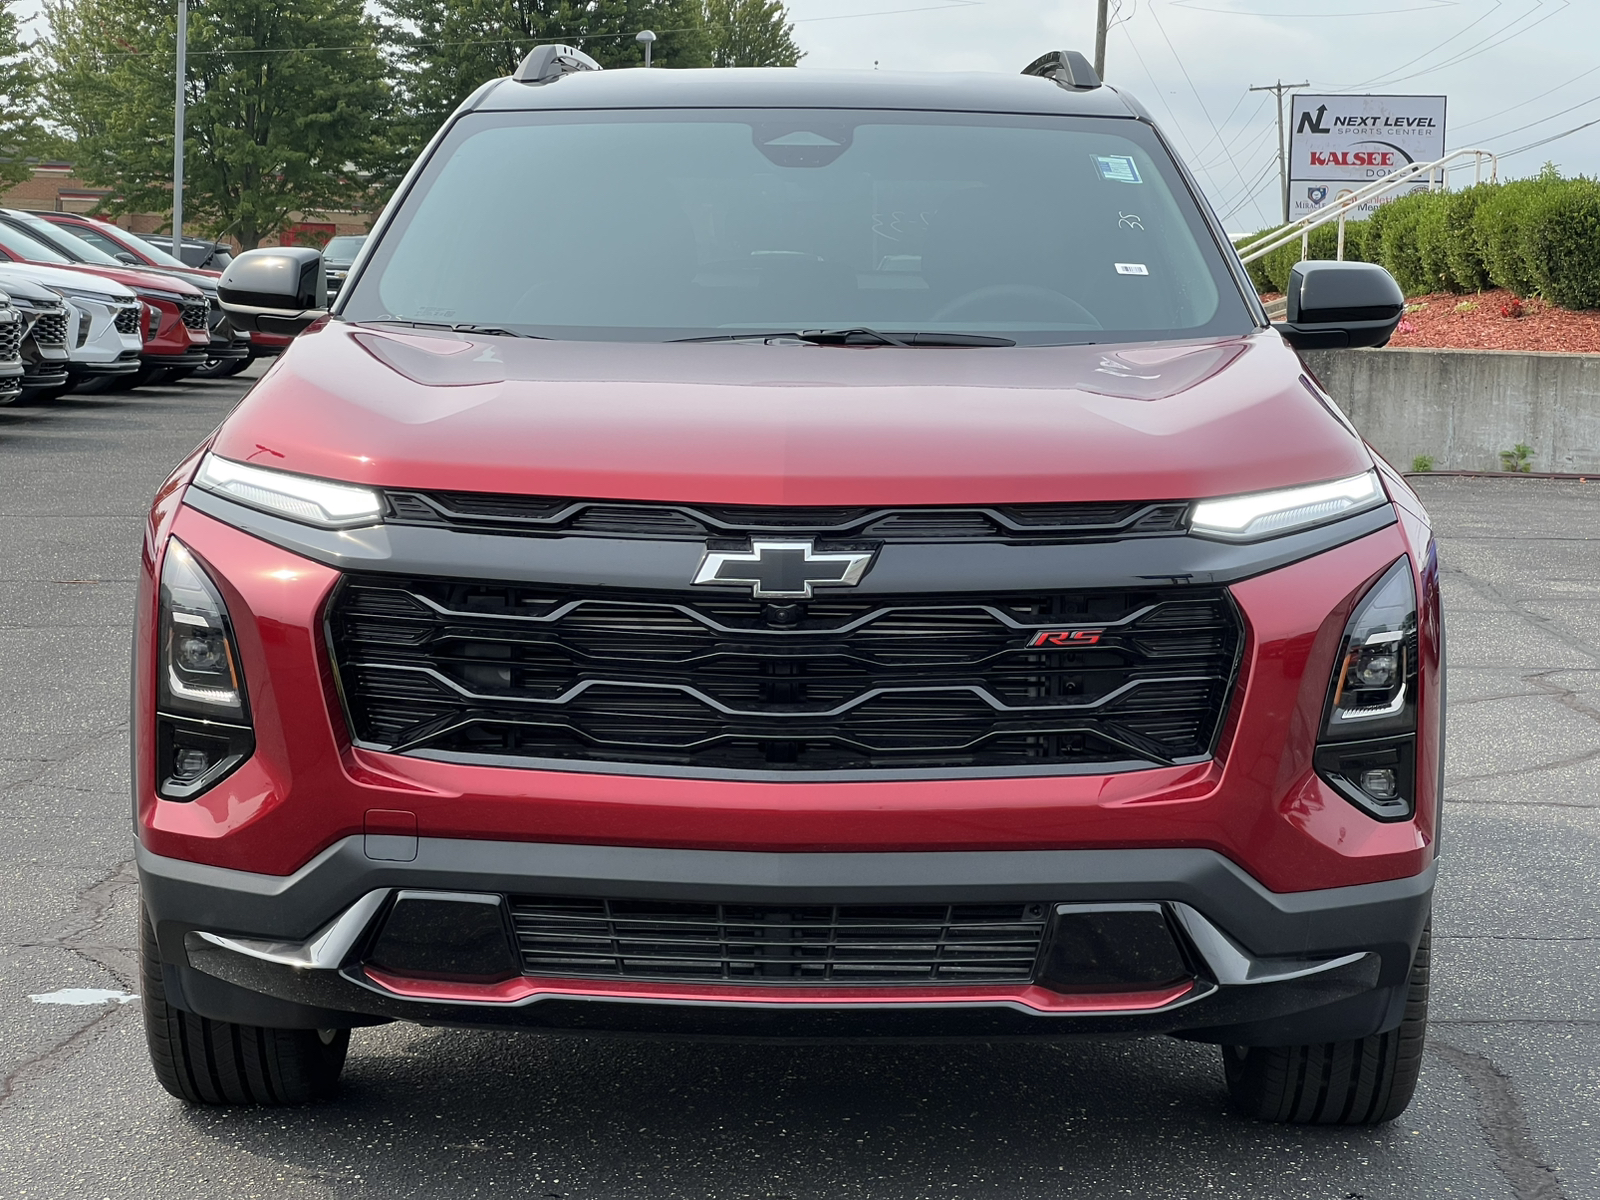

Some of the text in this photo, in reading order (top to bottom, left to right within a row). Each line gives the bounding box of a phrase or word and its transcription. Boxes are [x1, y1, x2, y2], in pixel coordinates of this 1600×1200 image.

[1334, 116, 1436, 128] NEXT LEVEL
[1387, 128, 1432, 136] CENTER
[1310, 151, 1394, 167] KALSEE
[1027, 629, 1103, 647] RS
